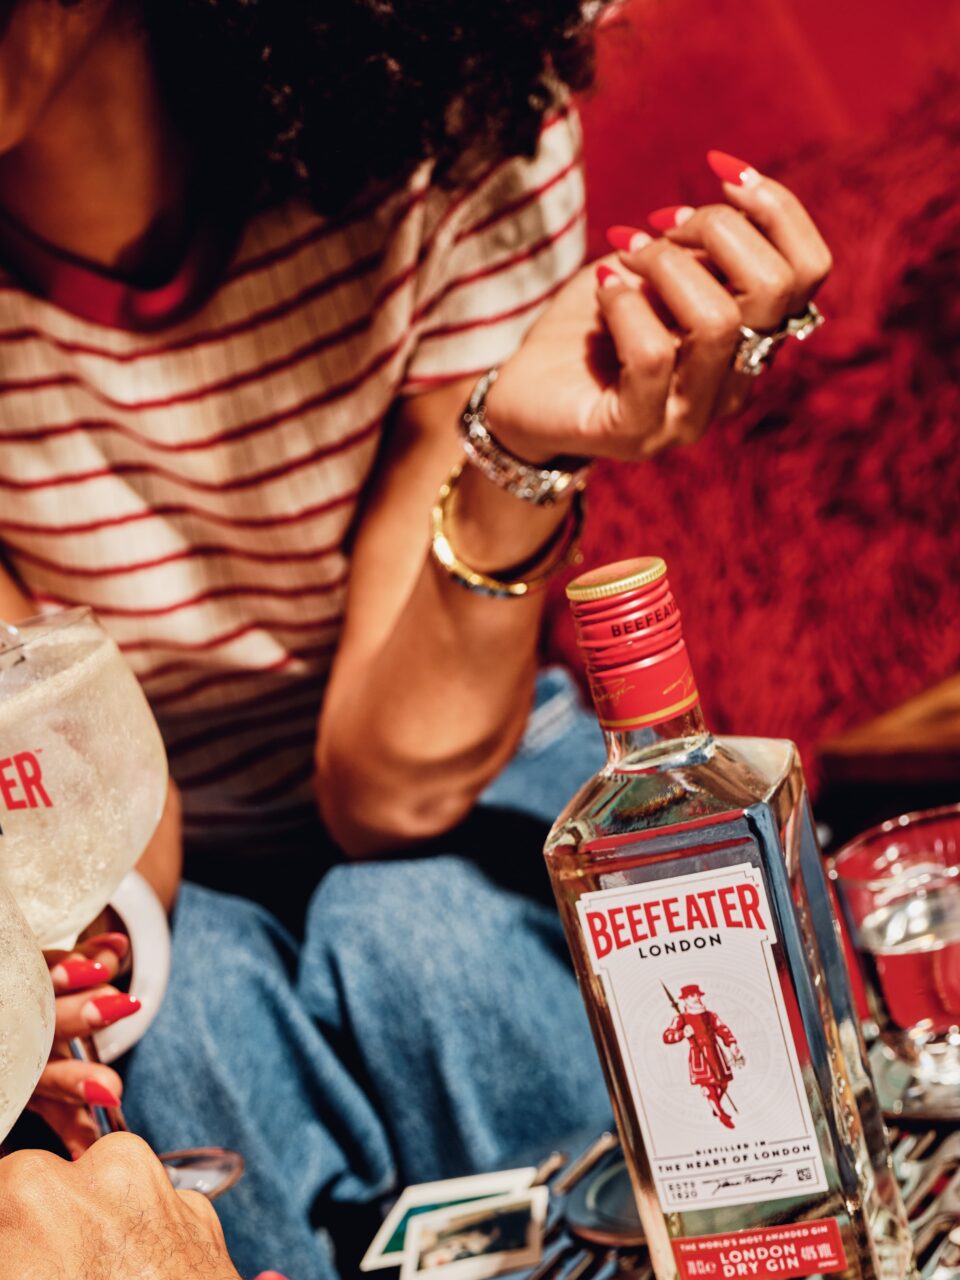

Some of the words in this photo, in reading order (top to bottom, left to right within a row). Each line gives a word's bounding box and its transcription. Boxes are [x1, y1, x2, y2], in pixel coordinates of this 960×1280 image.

[611, 602, 677, 637] BEEFEAT
[586, 884, 767, 960] BEEFEATER
[638, 934, 722, 959] LONDON
[658, 1164, 680, 1173] THE
[686, 1157, 727, 1170] HEART
[732, 1154, 748, 1164] OF
[754, 1144, 811, 1161] LONDON
[696, 1142, 749, 1156] DISTILLED
[755, 1140, 766, 1148] IN
[810, 1225, 828, 1236] GIN
[719, 1242, 797, 1265] LONDON
[722, 1260, 759, 1278] DRY
[765, 1256, 800, 1273] GIN
